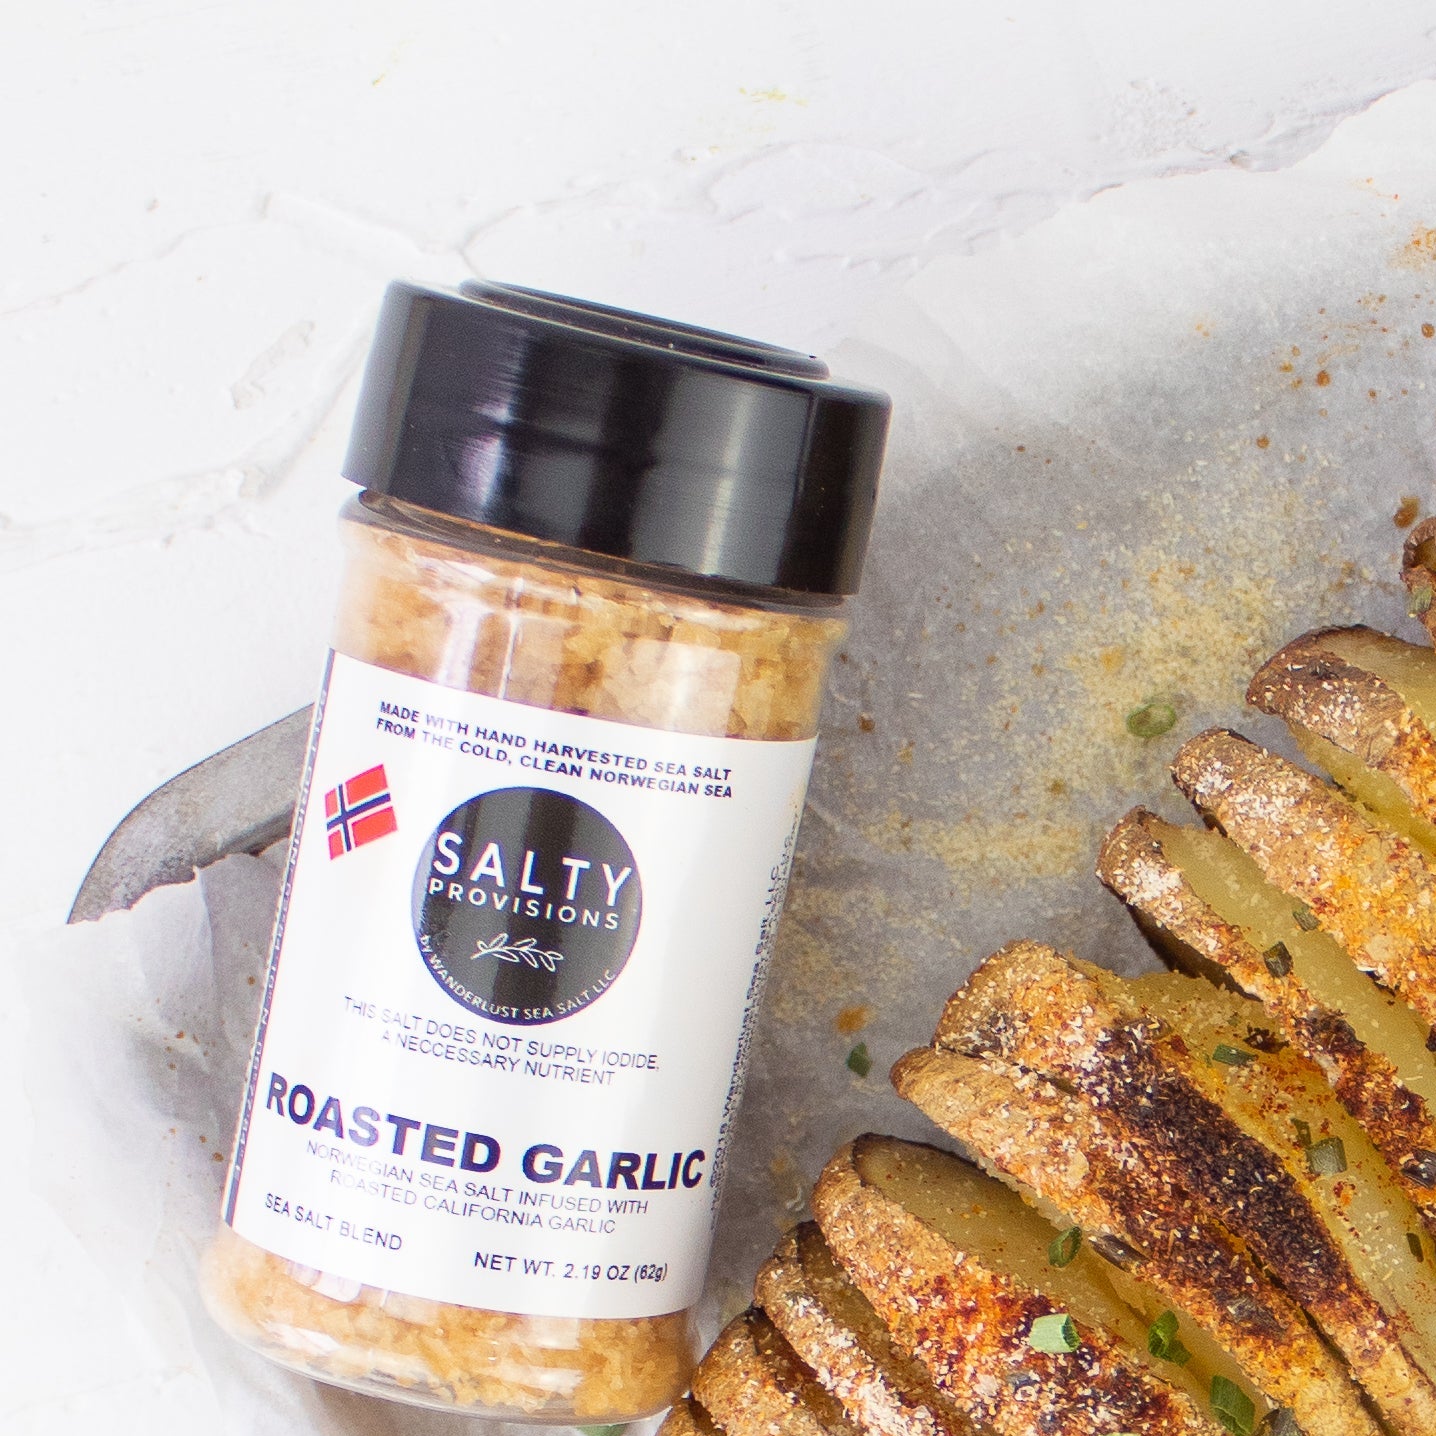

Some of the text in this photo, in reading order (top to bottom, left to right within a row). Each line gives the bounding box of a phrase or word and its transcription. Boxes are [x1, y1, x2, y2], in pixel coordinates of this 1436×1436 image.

[376, 717, 733, 798] FROM THE COLD, CLEAN NORWEGIAN SEA
[379, 701, 732, 781] MADE WITH HAND HARVESTED SEA SALT
[428, 877, 620, 930] PROVISIONS
[433, 830, 633, 907] SALTY
[420, 934, 616, 1020] by WANDERLUST SEA SALT LLC
[344, 996, 377, 1019] THIS
[380, 1008, 422, 1031] SALT
[426, 1020, 476, 1044] DOES
[482, 1032, 523, 1054] NOT
[526, 1041, 597, 1065] SUPPLY
[381, 1031, 616, 1087] A NECCESSARY NUTRIENT
[266, 1071, 706, 1191] ROASTED GARLIC
[306, 1139, 648, 1215] NORWEGIAN SEA SALT INFUSED WITH
[330, 1169, 616, 1235] ROASTED CALIFORNIA GARLIC
[264, 1193, 403, 1251] SEA SALT BLEND
[474, 1251, 668, 1284] NET WT. 2.19 OZ (62g)
